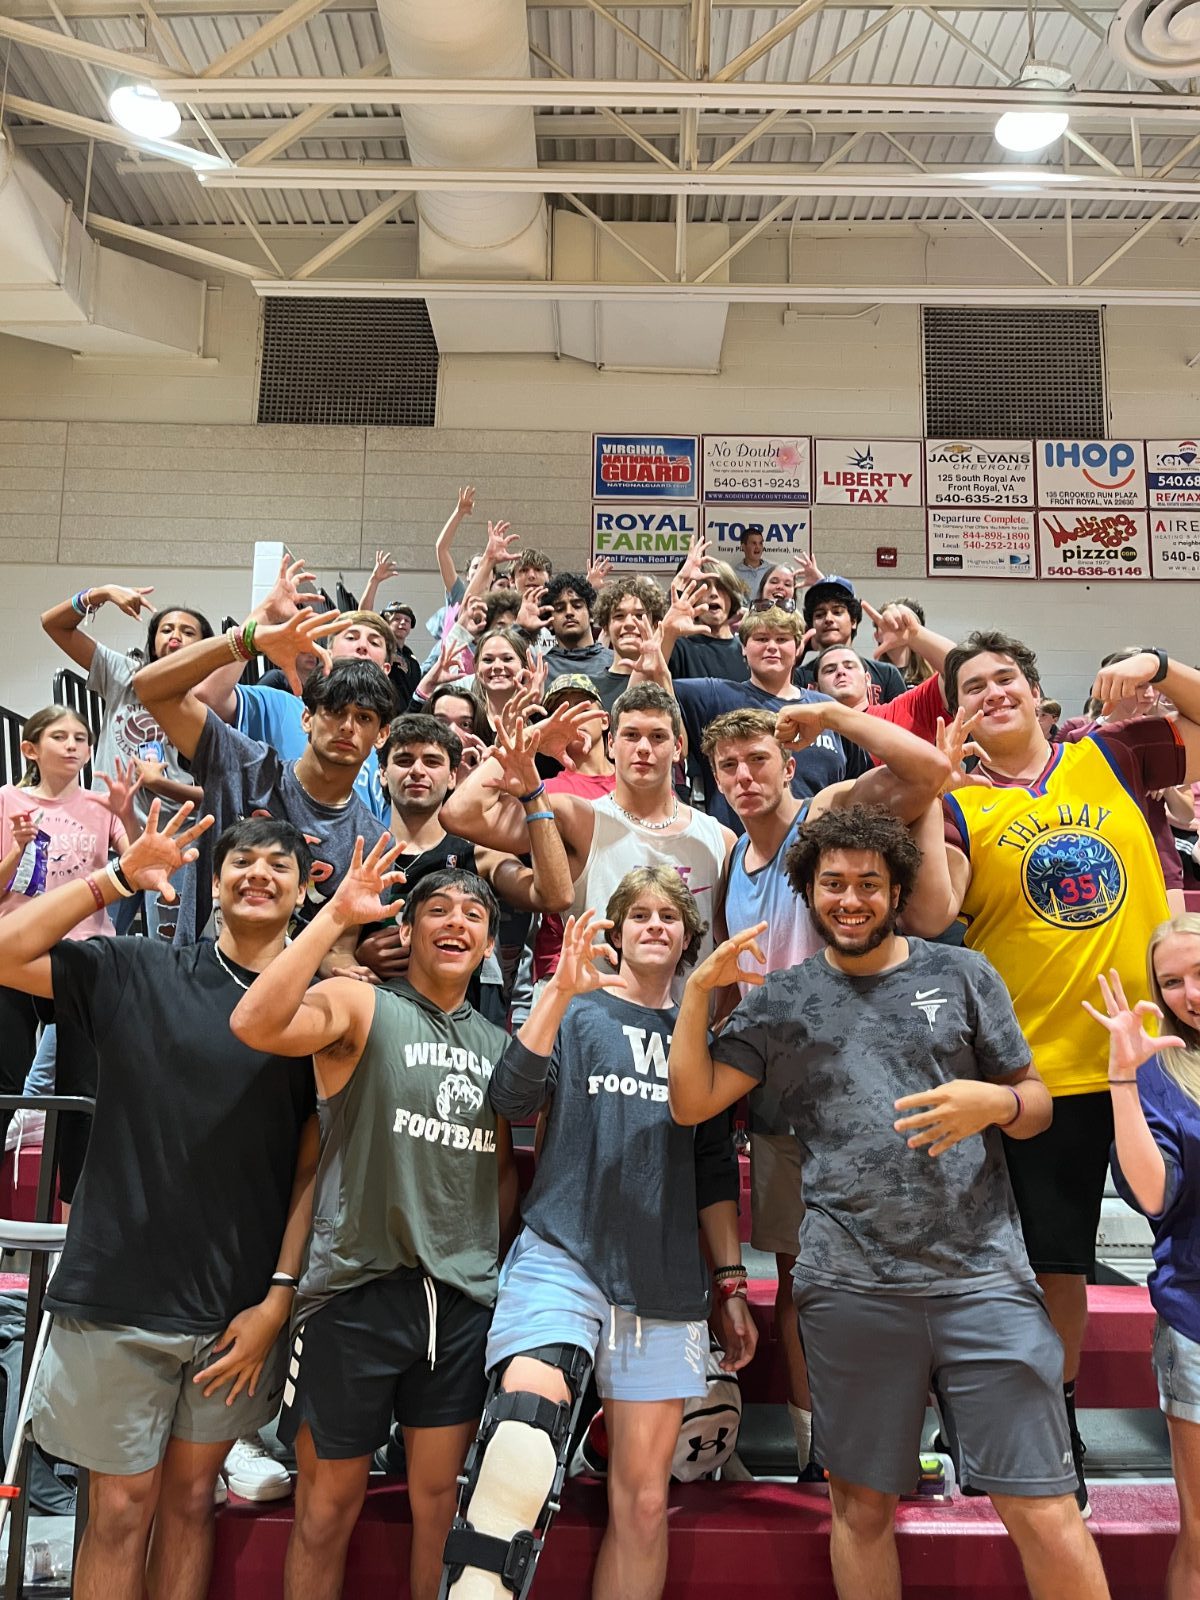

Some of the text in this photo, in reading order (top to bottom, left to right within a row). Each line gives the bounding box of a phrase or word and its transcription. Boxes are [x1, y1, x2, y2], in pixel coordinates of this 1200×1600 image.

[602, 444, 665, 455] VIRGINIA
[708, 441, 780, 457] No Doubt
[602, 455, 669, 464] NATIONAL
[928, 454, 1030, 463] JACK EVANS
[1045, 442, 1134, 477] IHOP
[601, 464, 691, 482] GUARD
[823, 471, 912, 487] LIBERTY
[714, 478, 800, 488] 540-631-9243
[983, 475, 1008, 484] Royal
[973, 484, 1000, 493] Royal,
[845, 489, 888, 503] TAX
[935, 494, 1028, 504] 540-635-2153
[1156, 493, 1200, 502] RE/MAX
[596, 514, 694, 531] ROYAL
[933, 514, 1026, 524] Departure Complete
[1156, 520, 1200, 532] AIRE
[596, 533, 690, 550] FARMS
[962, 531, 1030, 540] 844-898-1890
[963, 542, 1030, 550] 540-252-2149
[1062, 546, 1118, 562] pizza
[1162, 551, 1200, 561] 540-6
[1048, 566, 1142, 576] 540-636-6146
[998, 803, 1112, 850] THE BAY
[1060, 874, 1097, 904] 35
[404, 1042, 495, 1079] WILDCA
[588, 1074, 669, 1102] FOOTB
[392, 1108, 496, 1152] FOOTBALL
